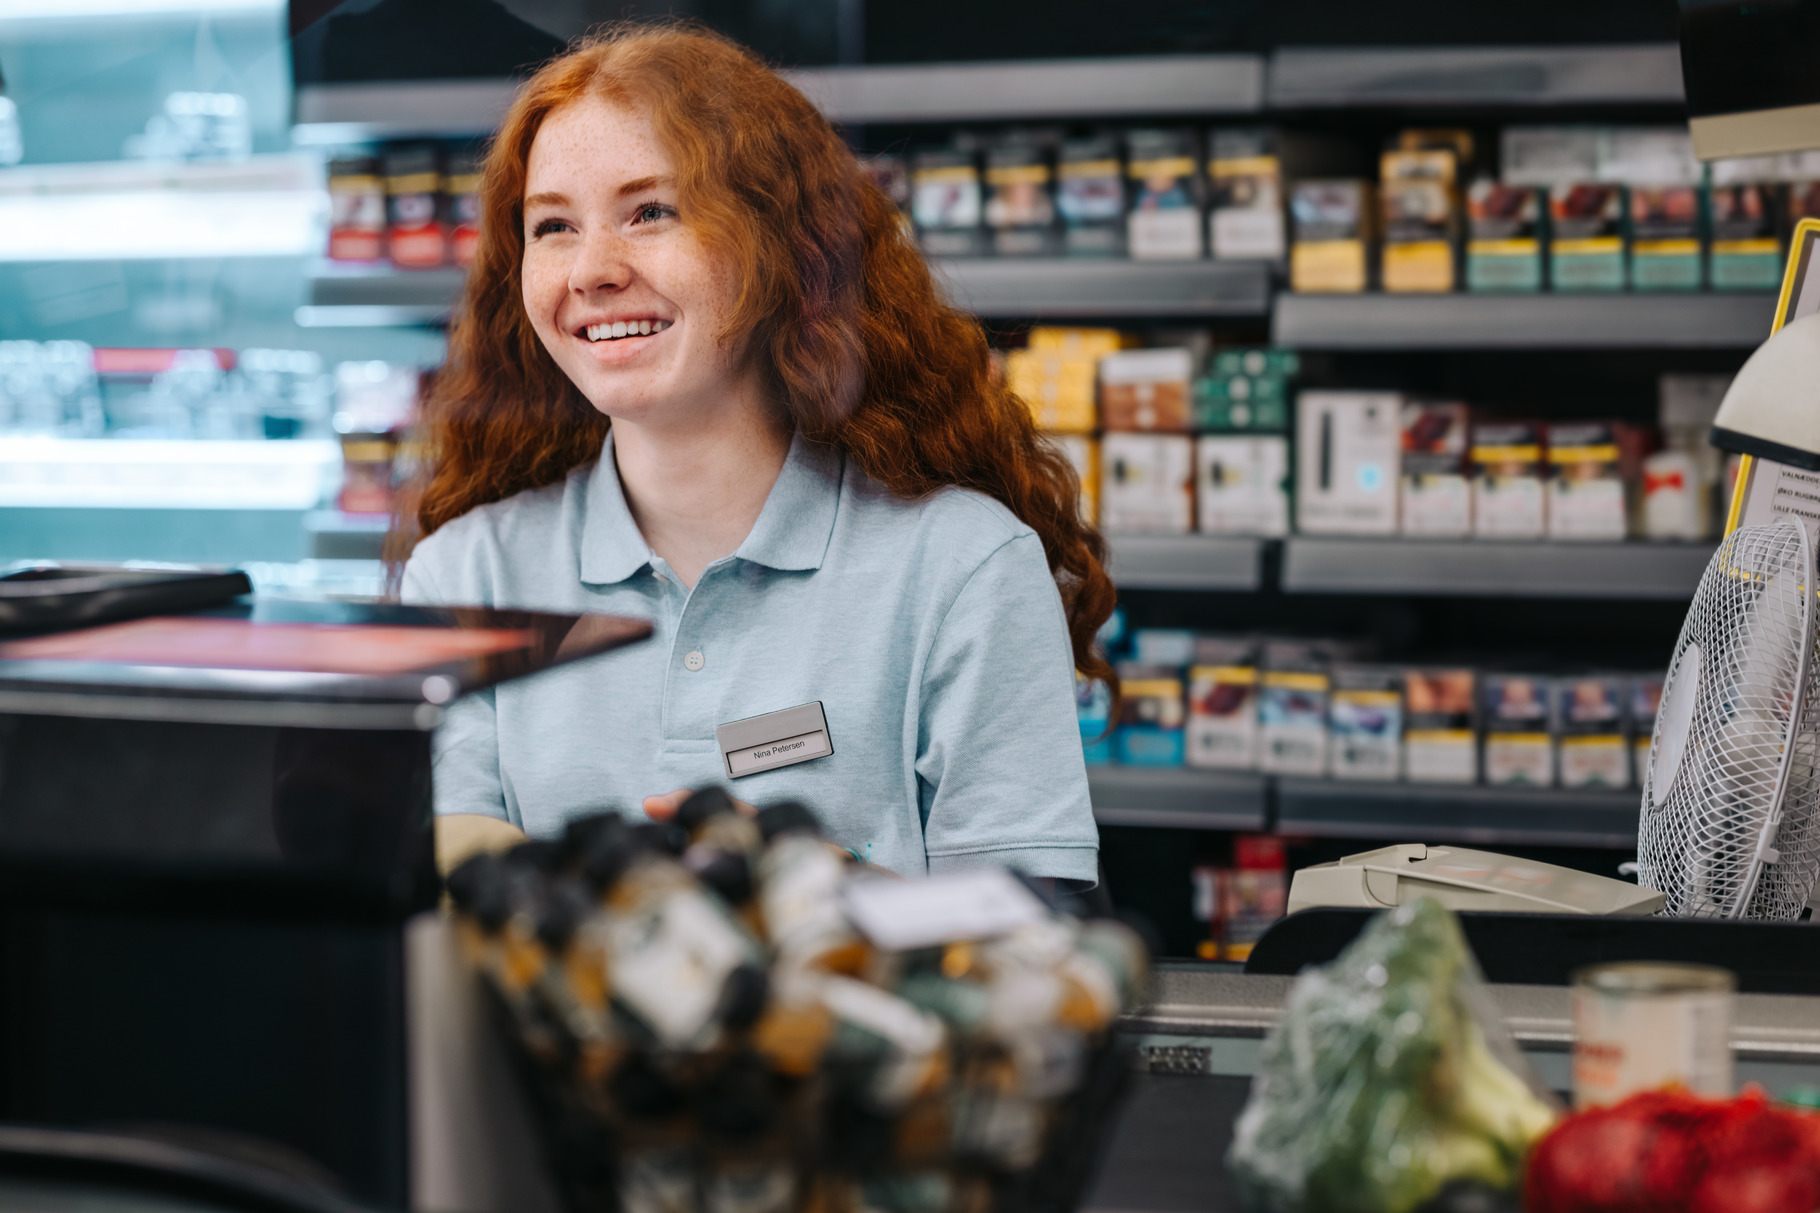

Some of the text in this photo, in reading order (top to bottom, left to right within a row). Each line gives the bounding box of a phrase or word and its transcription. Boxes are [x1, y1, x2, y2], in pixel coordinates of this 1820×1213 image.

[1773, 504, 1790, 513] LILLE
[754, 740, 805, 759] Nina Petersen
